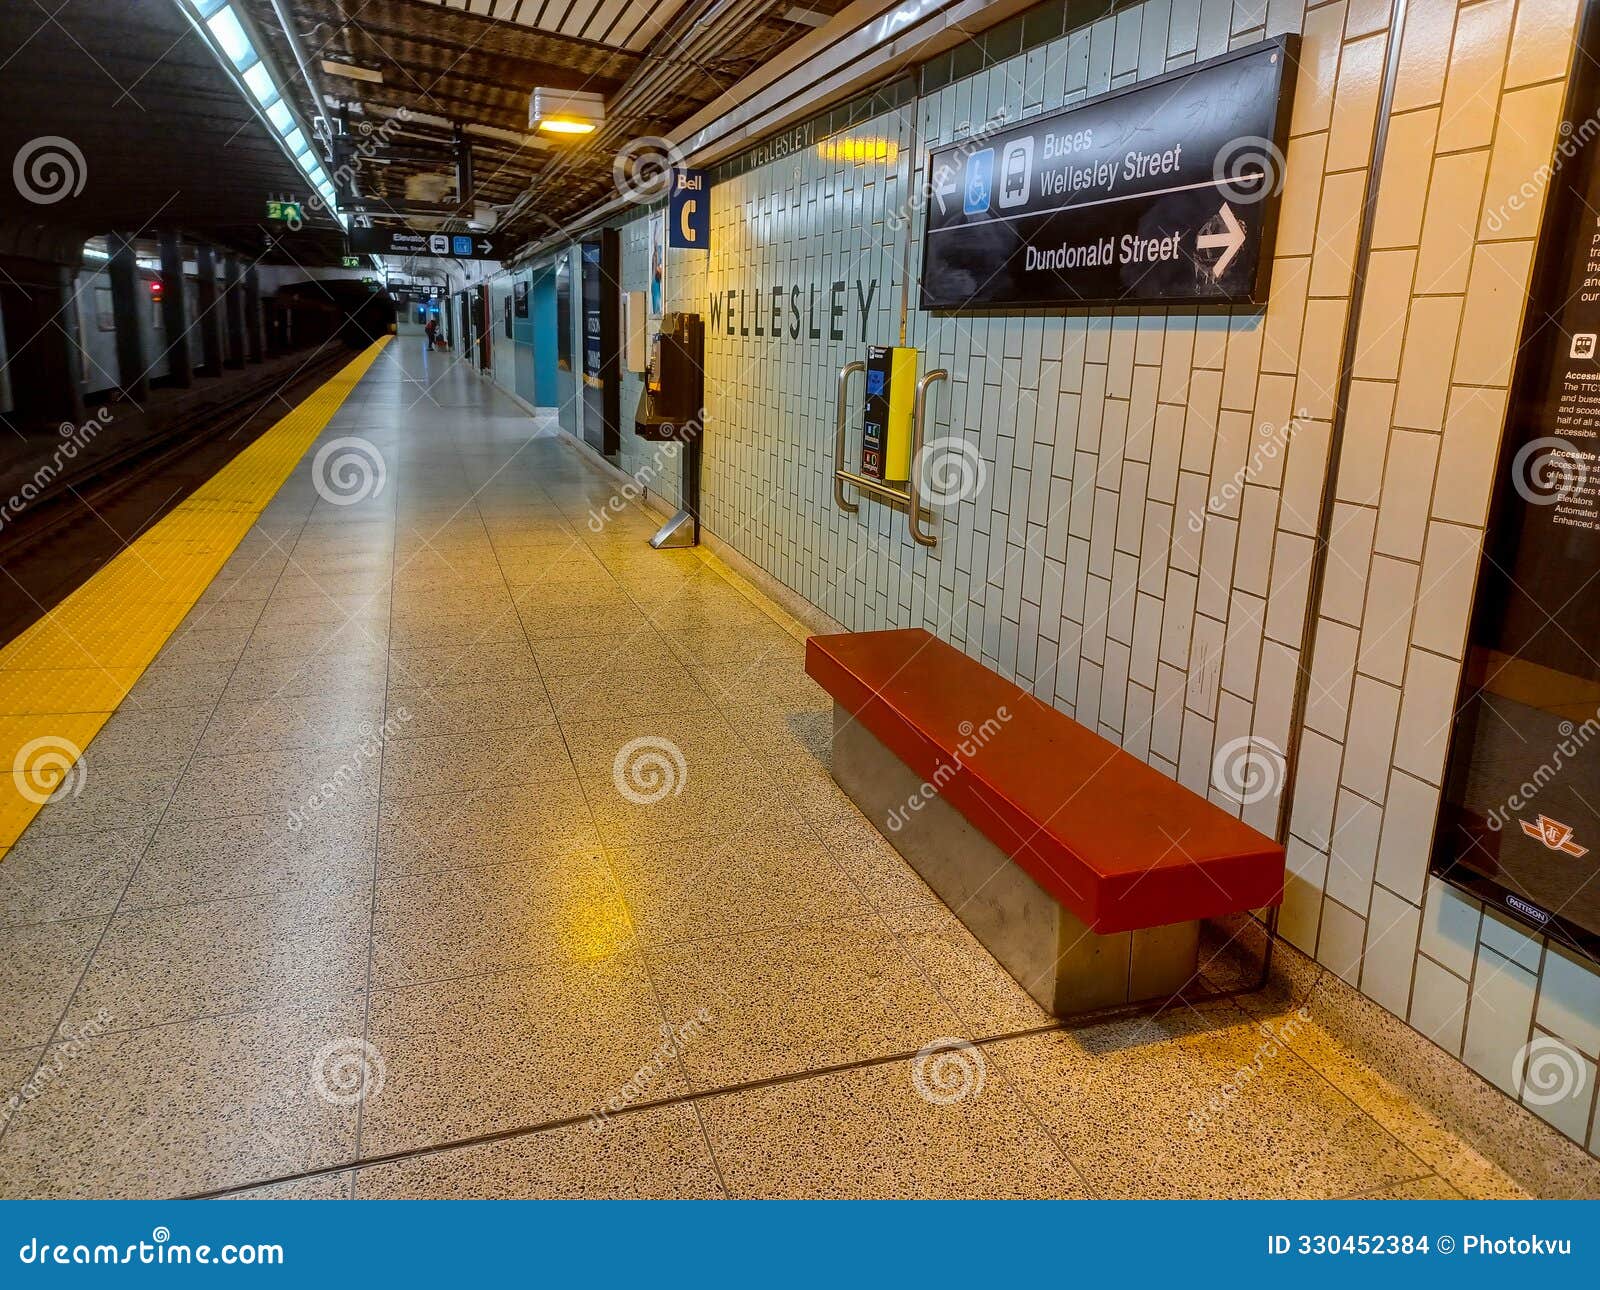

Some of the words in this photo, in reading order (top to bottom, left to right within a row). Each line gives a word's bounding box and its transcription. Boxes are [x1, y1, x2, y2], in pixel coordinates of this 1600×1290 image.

[750, 121, 811, 168] WELLESLEY
[1043, 128, 1092, 160] Buses
[1040, 161, 1118, 197] Wellesley
[1123, 143, 1183, 181] Street
[676, 174, 702, 191] Bell
[1025, 240, 1114, 272] Dundonald
[1118, 230, 1181, 264] Street
[709, 279, 878, 342] WELLESLEY
[1563, 382, 1579, 391] The
[1560, 394, 1577, 402] and
[1558, 405, 1575, 414] and
[1556, 415, 1572, 424] half
[1573, 417, 1582, 425] of
[1583, 418, 1593, 426] all
[1550, 448, 1596, 461] Accessible
[1547, 459, 1590, 472] Accessible
[1555, 471, 1587, 483] features
[1554, 482, 1596, 495] customers
[1557, 493, 1593, 506] Elevators
[1554, 504, 1598, 518] Automated
[1552, 515, 1593, 529] Enhanced
[1508, 898, 1546, 922] PATTISON
